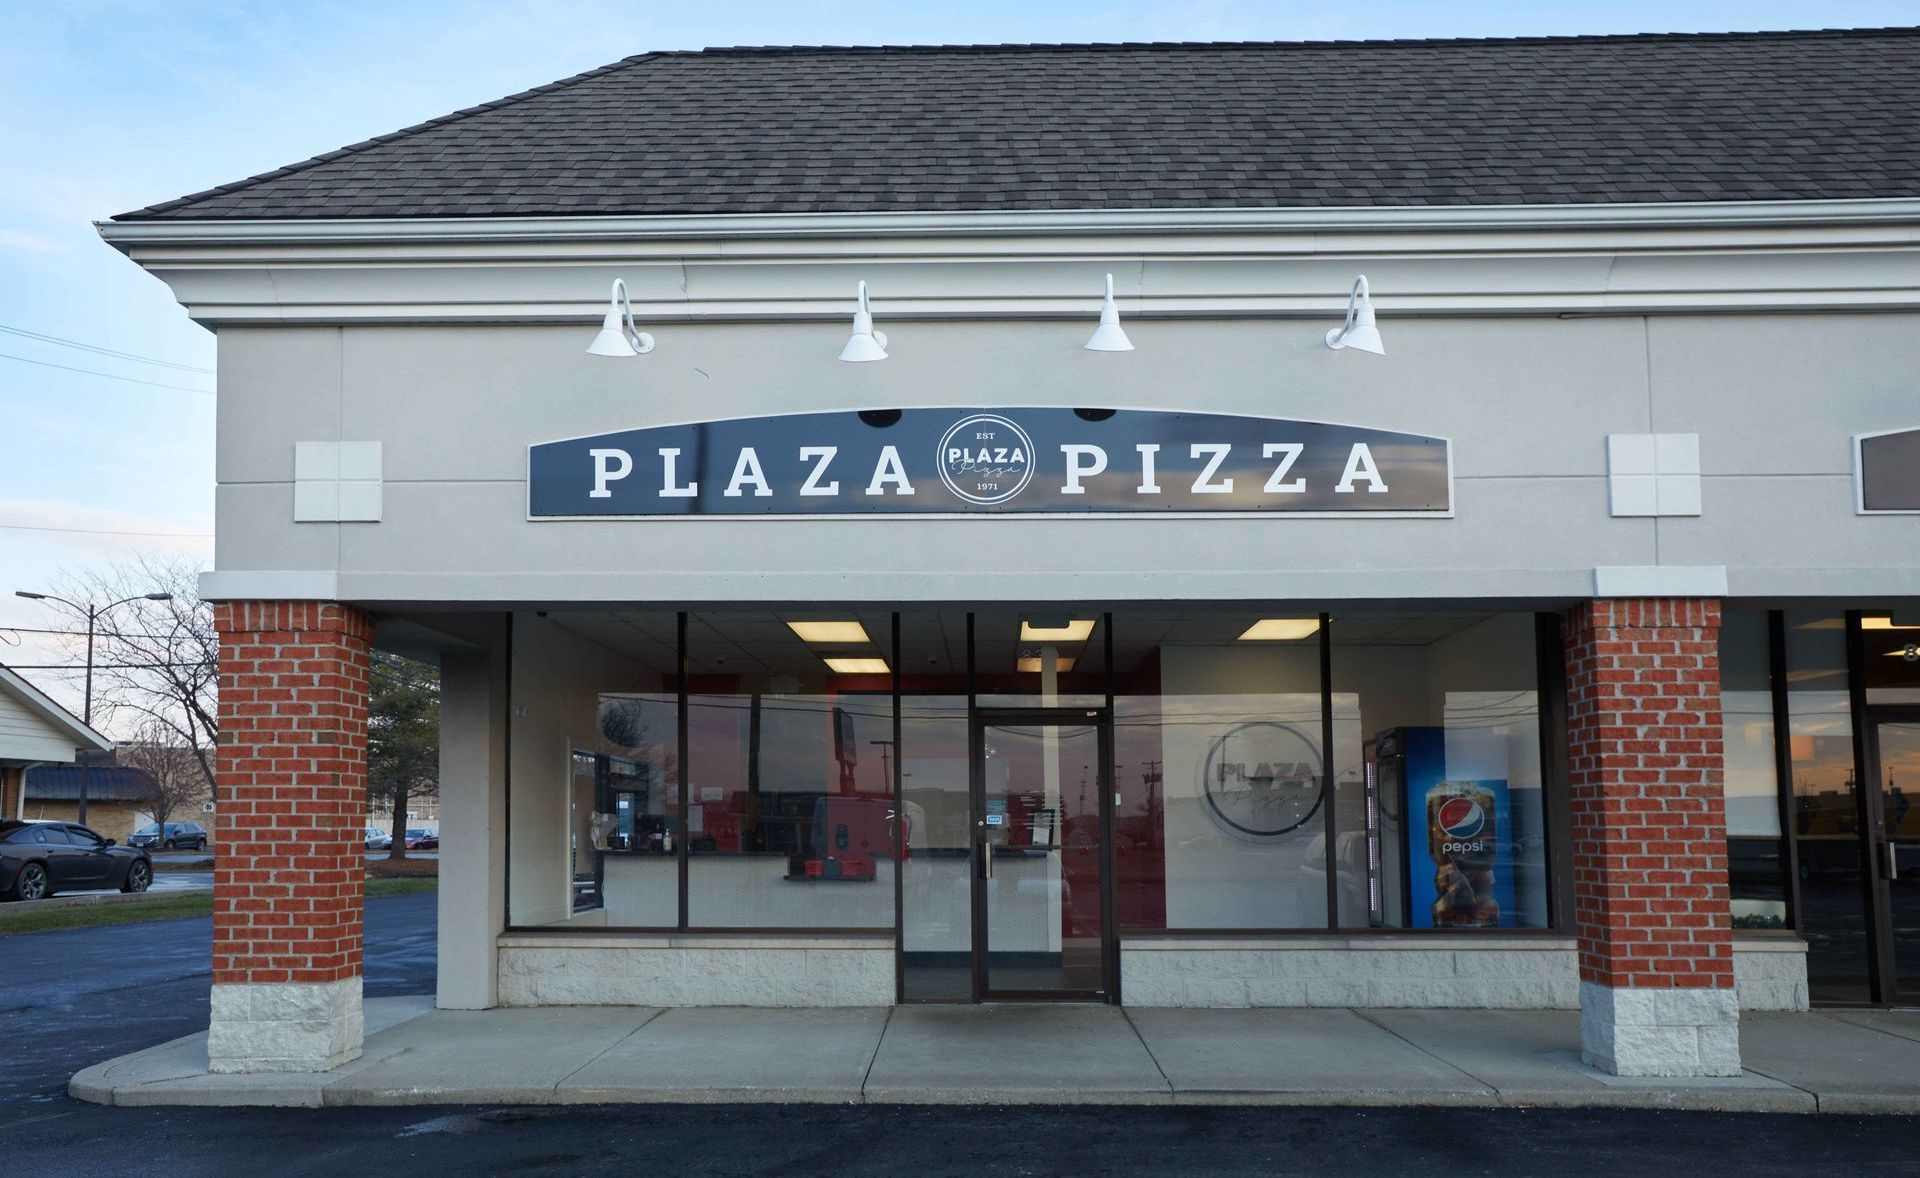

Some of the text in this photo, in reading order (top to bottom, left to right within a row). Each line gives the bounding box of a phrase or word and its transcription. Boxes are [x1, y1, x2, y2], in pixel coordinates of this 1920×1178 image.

[975, 432, 996, 440] EST
[948, 447, 1026, 464] PLAZA
[589, 442, 1389, 499] PLAZA PIZZA
[951, 458, 1021, 478] Pizza
[977, 483, 999, 491] 1971
[1216, 762, 1314, 783] PLAZA
[1442, 840, 1484, 855] pepsi
